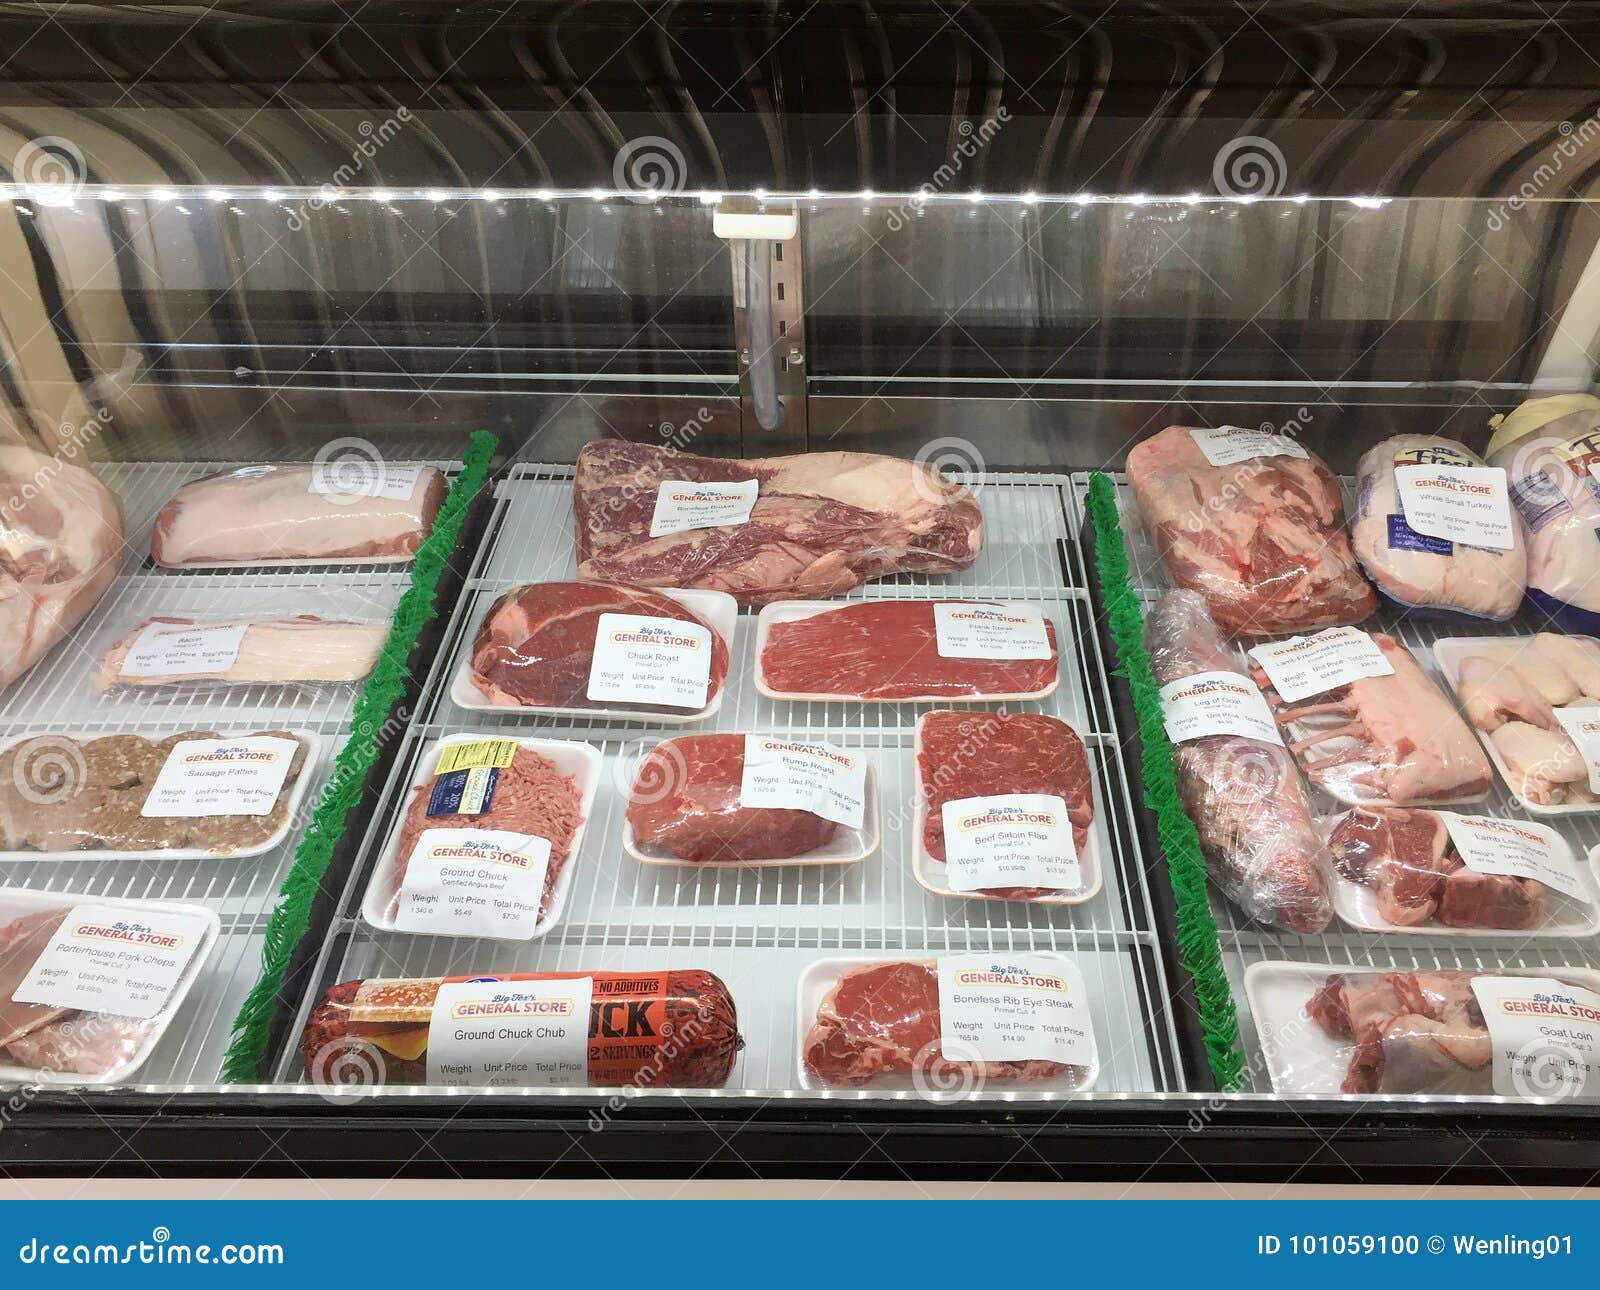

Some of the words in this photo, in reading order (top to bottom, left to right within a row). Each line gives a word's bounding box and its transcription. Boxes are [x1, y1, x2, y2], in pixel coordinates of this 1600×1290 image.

[1415, 480, 1458, 491] GENERAL
[1459, 485, 1492, 494] STORE
[1467, 501, 1493, 510] Turkey
[614, 634, 660, 644] GENERAL
[663, 636, 696, 648] STORE
[627, 652, 653, 660] Chuck
[655, 653, 679, 662] Roast
[600, 672, 624, 680] Weight
[687, 680, 704, 688] Price
[1172, 685, 1218, 701] GENERAL
[1221, 685, 1252, 695] STORE
[186, 753, 234, 761] GENERAL
[239, 752, 274, 760] STORE
[764, 743, 815, 755] GENERAL
[818, 749, 850, 766] STORE
[227, 768, 258, 776] Patties
[782, 757, 808, 767] Rump
[811, 761, 835, 775] Roast
[753, 776, 779, 784] Weight
[805, 779, 823, 789] Price
[161, 789, 186, 797] Weight
[828, 788, 843, 799] Total
[844, 794, 860, 806] Price
[963, 814, 1014, 828] GENERAL
[1017, 814, 1052, 824] STORE
[975, 834, 995, 845] Beef
[998, 831, 1025, 840] Sirloin
[1028, 831, 1048, 840] Flap
[433, 848, 486, 858] GENERAL
[489, 851, 527, 866] STORE
[957, 857, 984, 865] Weight
[1037, 855, 1053, 863] Total
[440, 868, 475, 878] Ground
[477, 871, 508, 881] Chuck
[442, 879, 467, 887] Certified
[469, 881, 488, 889] Angus
[412, 894, 439, 904] Weight
[448, 896, 464, 904] Unit
[466, 896, 486, 905] Price
[493, 899, 511, 908] Total
[513, 902, 534, 911] Price
[78, 926, 134, 941] GENERAL
[137, 934, 178, 948] STORE
[56, 943, 115, 959] Porterhouse
[117, 952, 141, 962] Pork
[143, 955, 176, 967] Chops
[40, 968, 68, 977] Weight
[990, 965, 1006, 974] Big
[78, 972, 95, 980] Unit
[96, 975, 118, 984] Price
[960, 974, 1018, 985] GENERAL
[1022, 976, 1062, 989] STORE
[125, 979, 145, 988] Total
[146, 983, 167, 993] Price
[599, 982, 613, 993] NO
[614, 981, 659, 993] ADDITIVES
[492, 994, 510, 1004] Big
[953, 995, 1001, 1005] Boneless
[1003, 996, 1020, 1006] Rib
[1023, 998, 1043, 1009] Eye
[1046, 1000, 1074, 1009] Steak
[1533, 994, 1551, 1004] Big
[457, 1001, 520, 1015] GENERAL
[524, 1002, 567, 1013] STORE
[1504, 1001, 1568, 1015] GENERAL
[953, 1021, 983, 1031] Weight
[994, 1022, 1011, 1030] Unit
[1013, 1023, 1035, 1031] Price
[1041, 1025, 1062, 1033] Total
[1064, 1028, 1084, 1037] Price
[454, 1029, 495, 1041] Ground
[498, 1028, 533, 1039] Chuck
[536, 1027, 566, 1038] Chub
[1540, 1026, 1567, 1038] Goat
[1570, 1030, 1593, 1041] Loin
[1506, 1050, 1537, 1064] Weight
[441, 1064, 472, 1074] Weight
[484, 1063, 502, 1072] Unit
[505, 1063, 528, 1072] Price
[536, 1063, 557, 1072] Total
[559, 1062, 582, 1071] Price
[1549, 1057, 1566, 1066] Unit
[1568, 1060, 1590, 1071] Price
